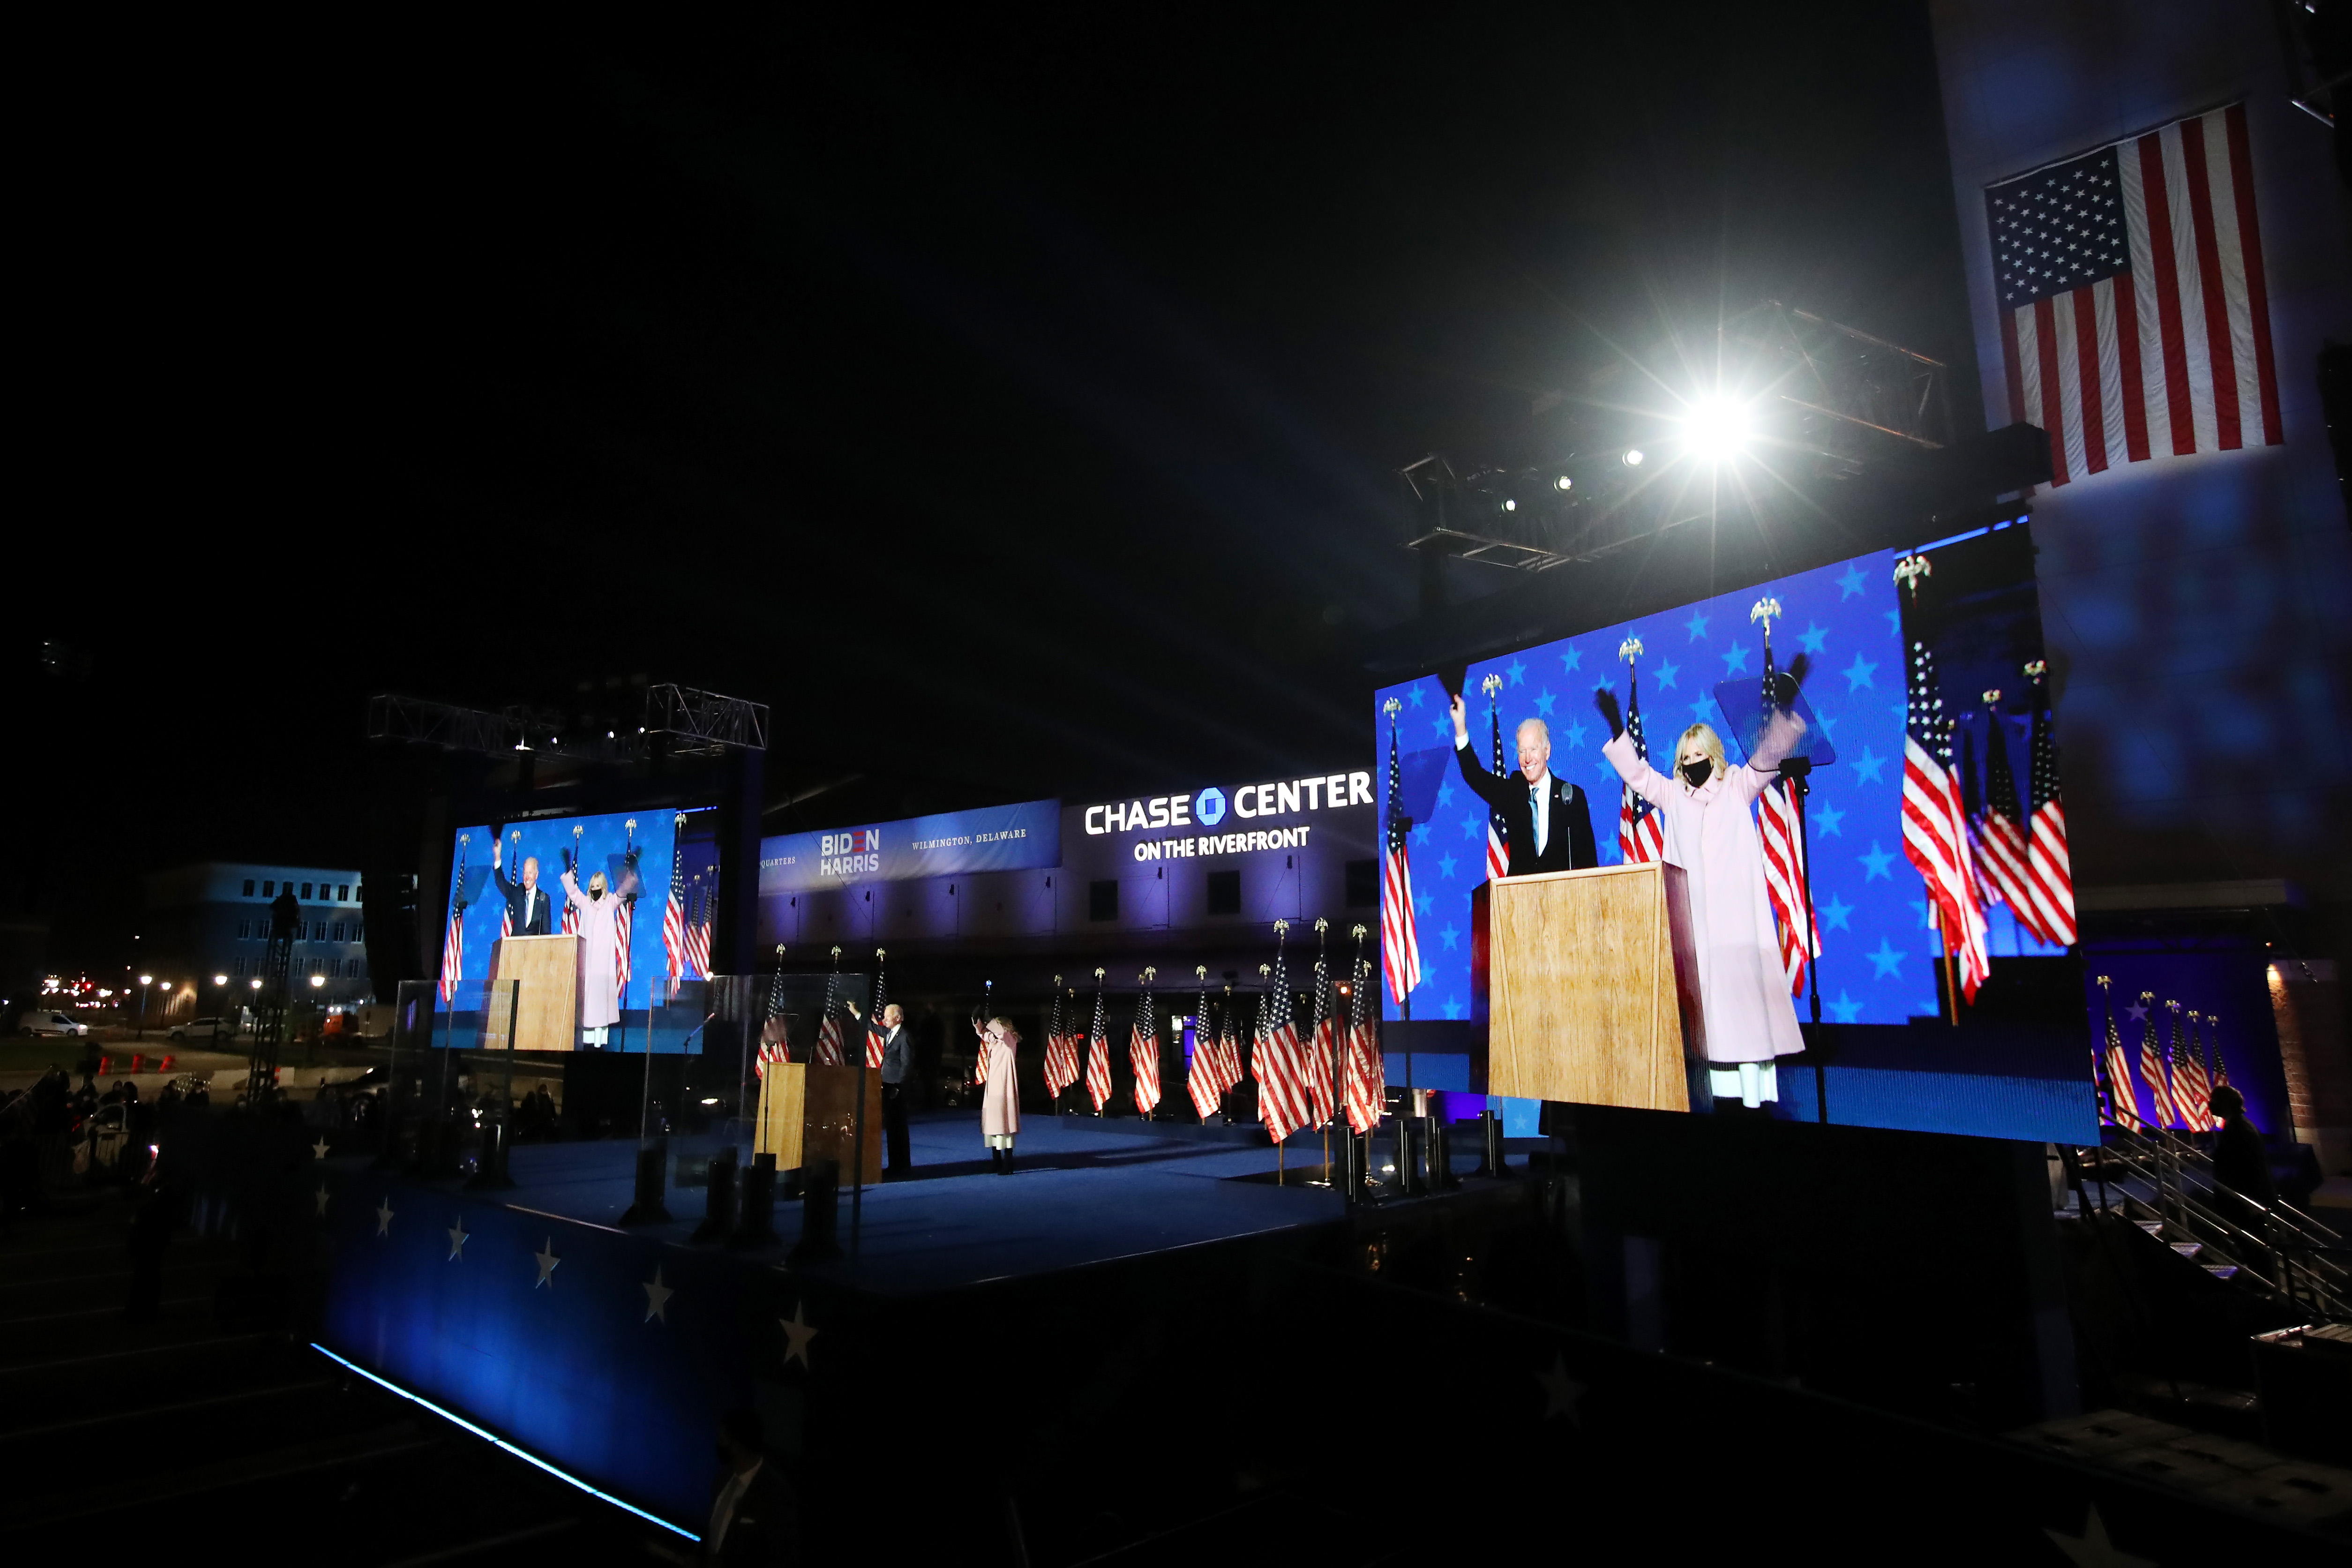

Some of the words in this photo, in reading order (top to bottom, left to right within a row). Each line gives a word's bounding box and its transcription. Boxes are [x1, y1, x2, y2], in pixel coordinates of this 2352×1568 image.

[1085, 795, 1191, 835] CHASE
[1234, 771, 1374, 818] CENTER
[821, 829, 879, 857] BIDEN
[912, 836, 973, 850] WILMINGTON,
[976, 829, 1026, 843] DELAWARE
[1134, 841, 1161, 862] ON
[1162, 839, 1195, 859] THE
[1198, 826, 1310, 856] RIVERFRONT
[759, 856, 795, 869] QUARTERS
[820, 853, 879, 876] HARRIS
